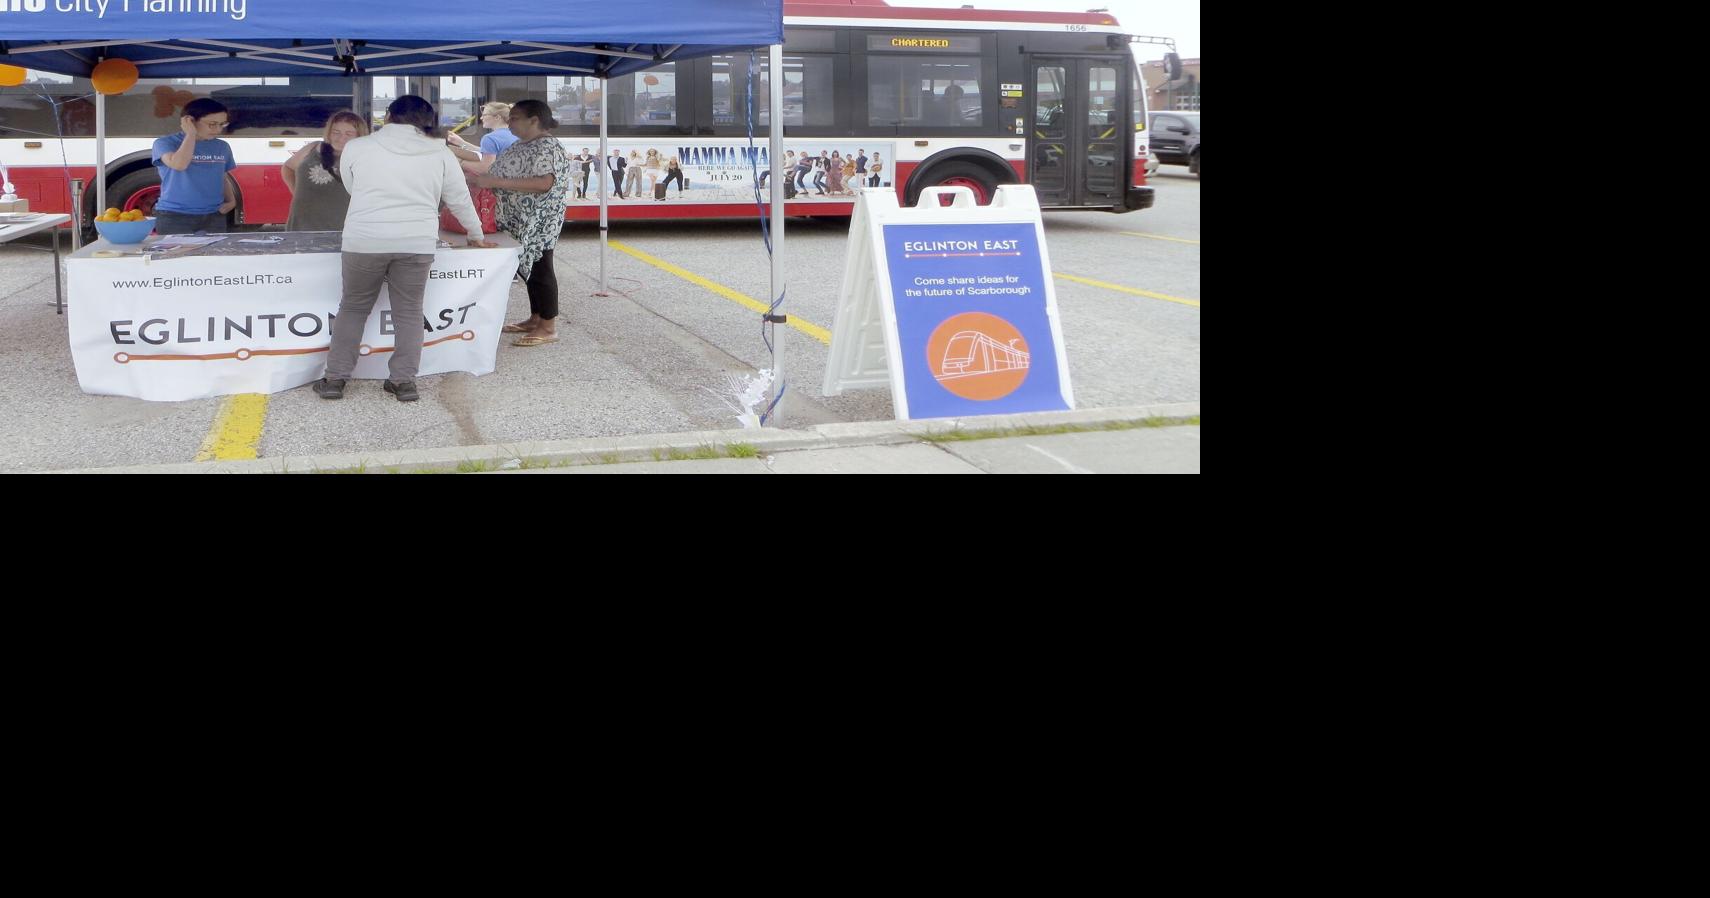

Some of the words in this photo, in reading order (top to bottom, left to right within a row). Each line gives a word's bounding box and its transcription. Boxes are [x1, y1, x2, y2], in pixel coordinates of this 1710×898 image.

[1065, 24, 1087, 32] 1656
[891, 38, 949, 47] CHARTERED
[678, 146, 737, 165] MAMMA
[904, 241, 978, 251] EGLINTON
[984, 240, 1018, 250] EAST
[112, 274, 293, 290] www.EglintonEastLRT.ca
[914, 277, 945, 286] Come
[947, 276, 975, 285] share
[977, 275, 1003, 284] ideas
[1005, 275, 1019, 283] for
[905, 289, 921, 297] the
[924, 288, 953, 296] future
[955, 287, 966, 295] of
[967, 285, 1031, 295] Scarborough
